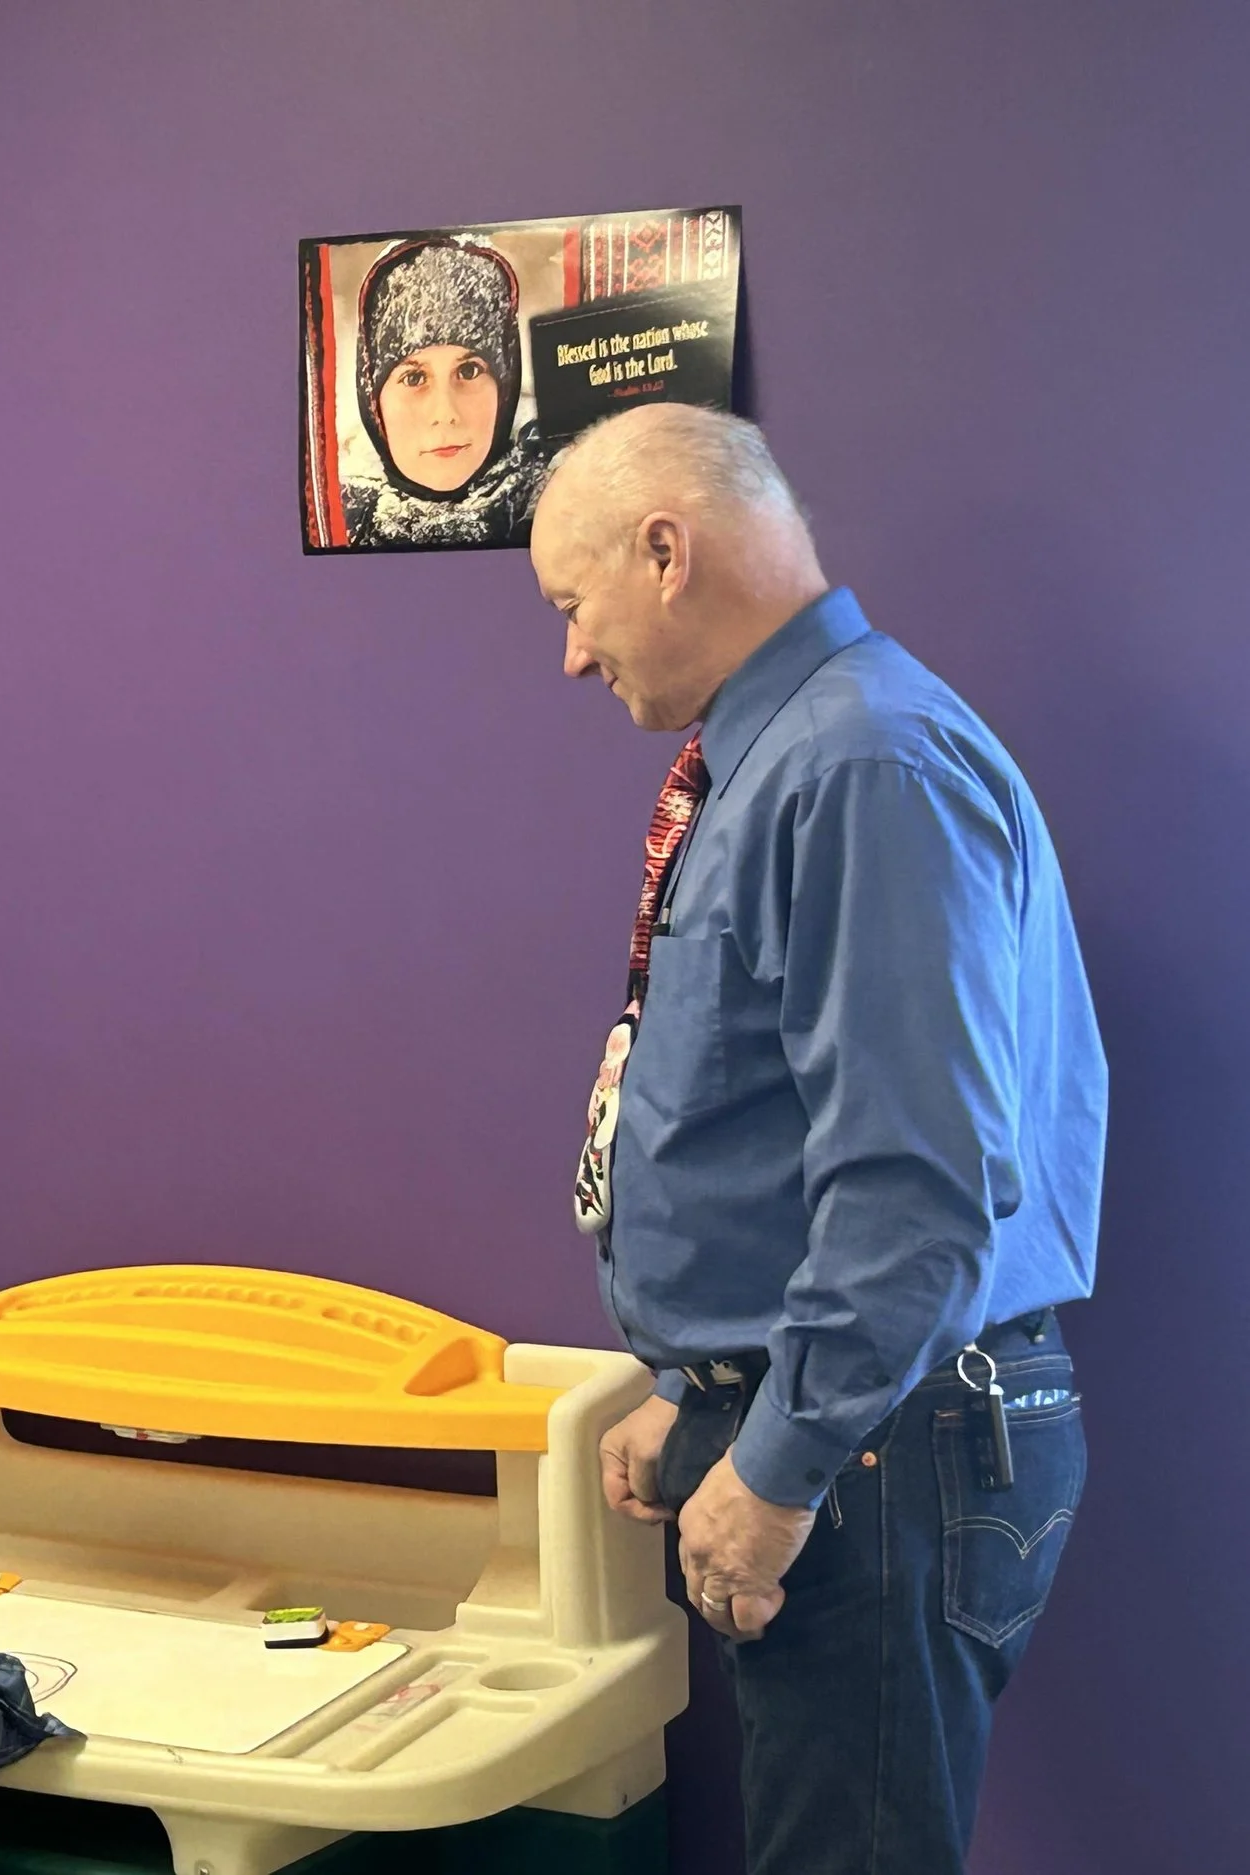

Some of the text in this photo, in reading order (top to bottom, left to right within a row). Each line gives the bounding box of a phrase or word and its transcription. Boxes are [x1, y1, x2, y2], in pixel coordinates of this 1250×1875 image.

[557, 319, 709, 367] Blessed is the nation whose
[589, 349, 678, 386] God is the Lord.
